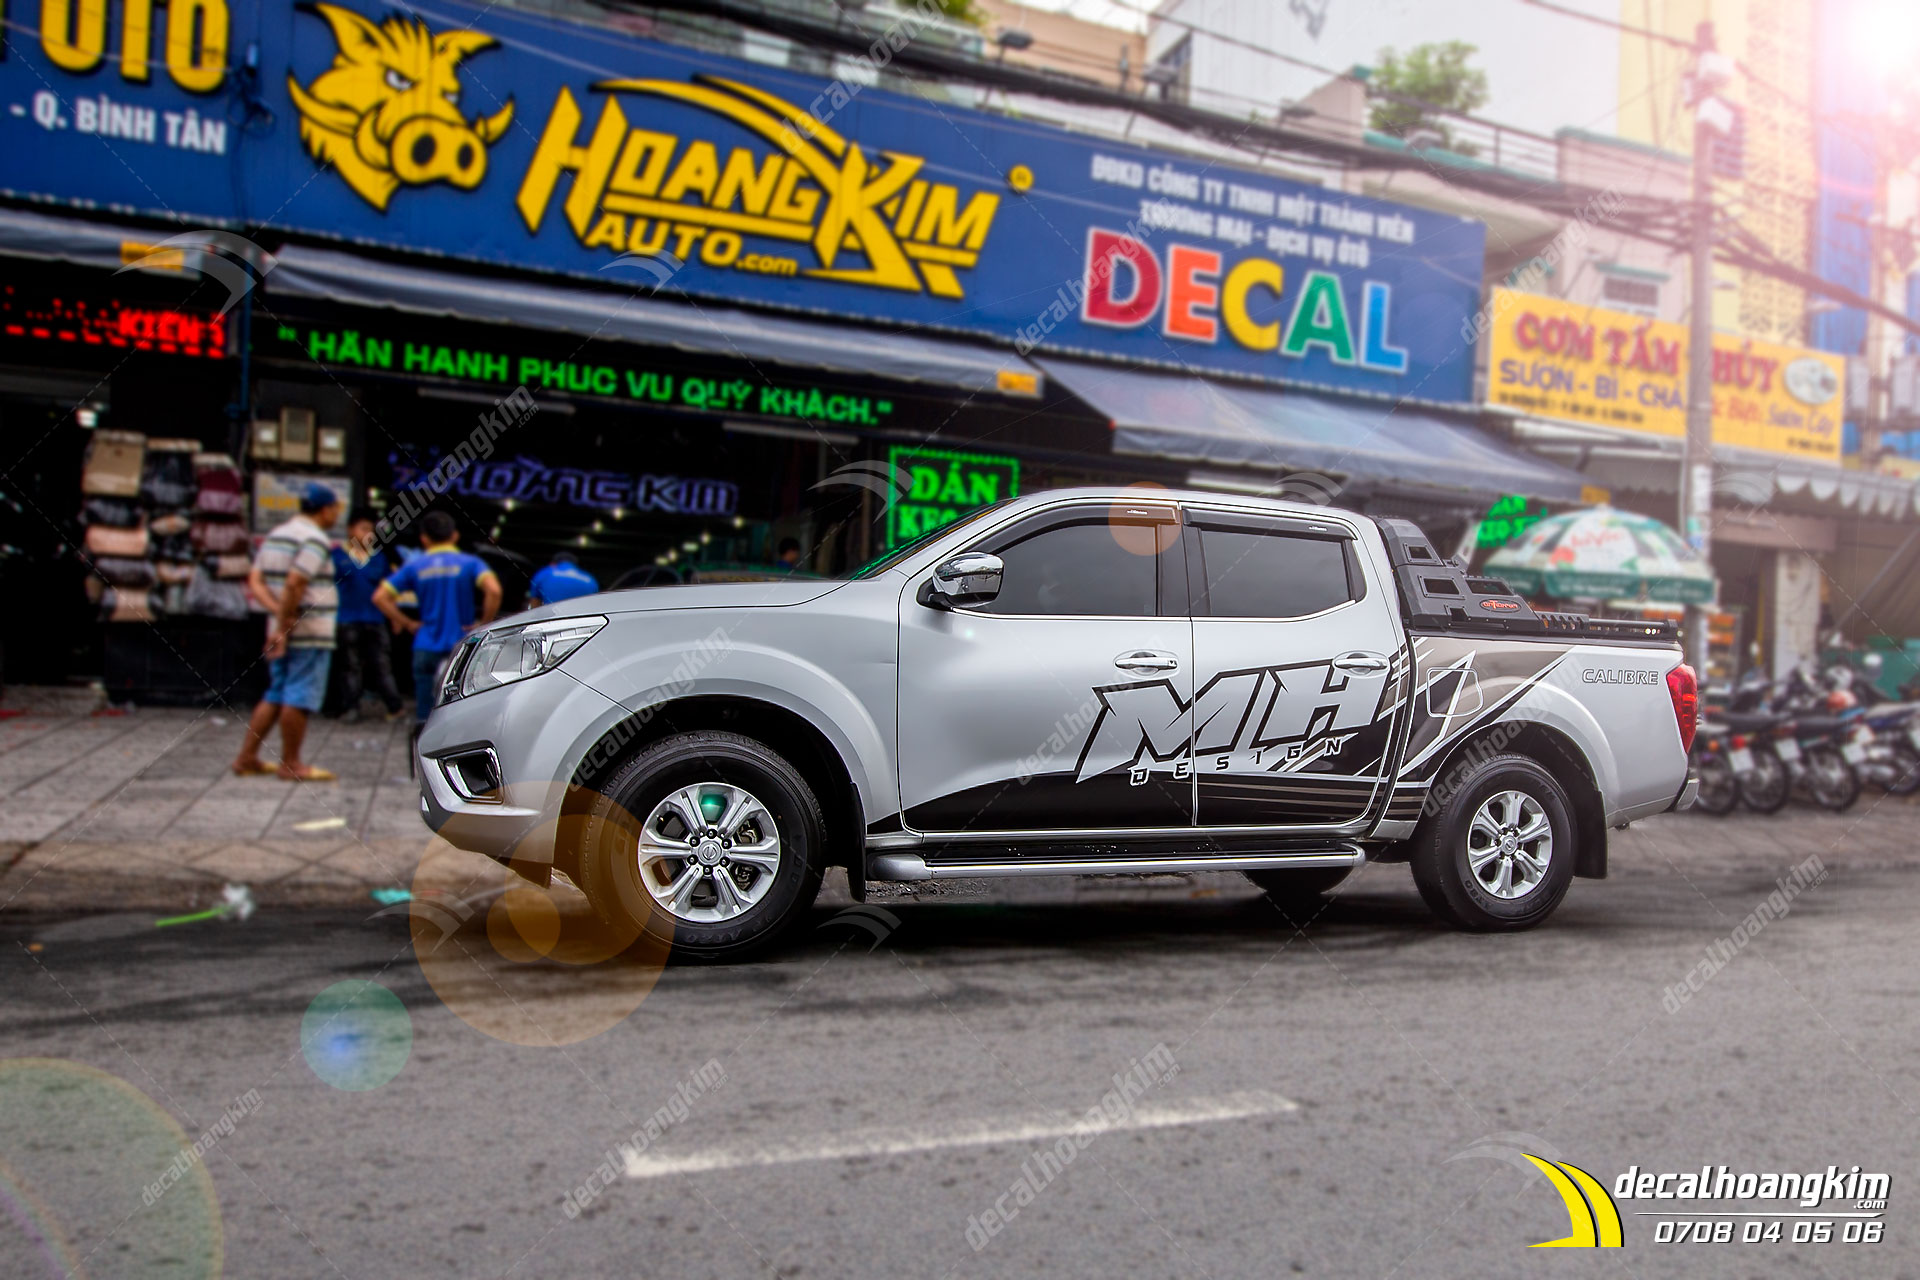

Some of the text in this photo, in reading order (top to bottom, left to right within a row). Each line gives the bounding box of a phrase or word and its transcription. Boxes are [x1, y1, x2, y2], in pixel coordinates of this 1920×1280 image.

[34, 91, 67, 130] Q.
[76, 93, 157, 142] BÌNH
[164, 108, 228, 154] TÂN
[1203, 179, 1225, 205] TY
[1081, 226, 1408, 374] DECAL
[908, 461, 1000, 505] DÁN
[1582, 668, 1659, 686] CALIBRE
[1128, 737, 1342, 786] DESIGN
